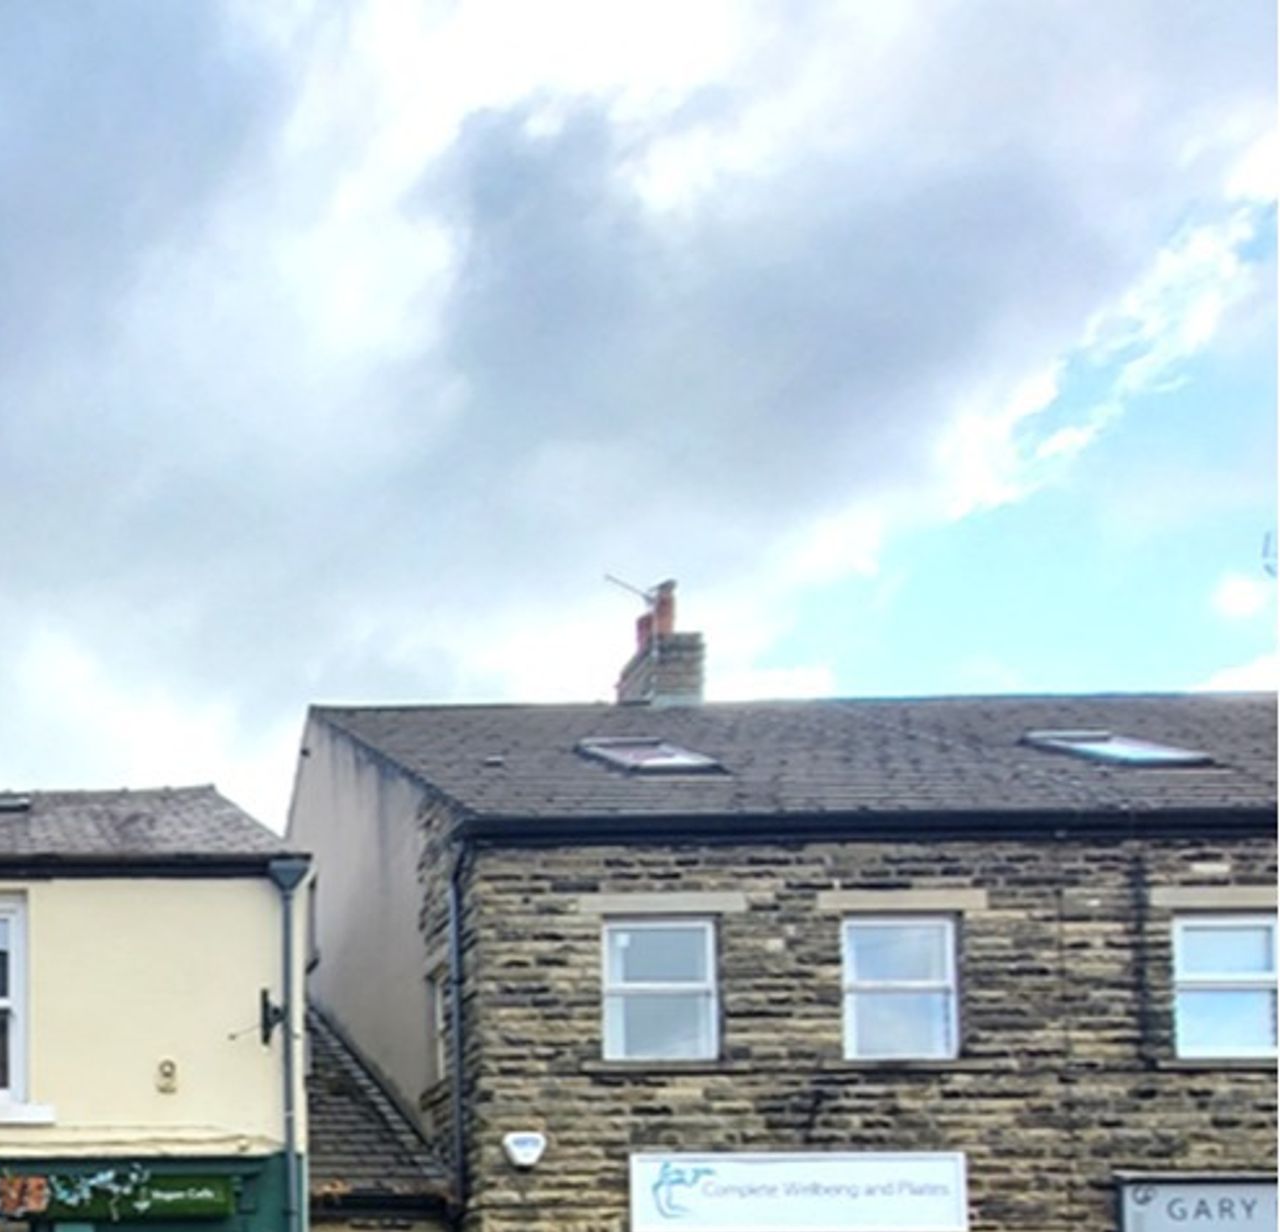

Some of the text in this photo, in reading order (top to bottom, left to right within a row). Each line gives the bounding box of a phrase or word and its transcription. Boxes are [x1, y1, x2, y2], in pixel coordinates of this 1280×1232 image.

[701, 1180, 779, 1199] Complete
[782, 1179, 859, 1199] Wellbeing
[865, 1179, 895, 1196] and
[1166, 1197, 1258, 1221] GARY
